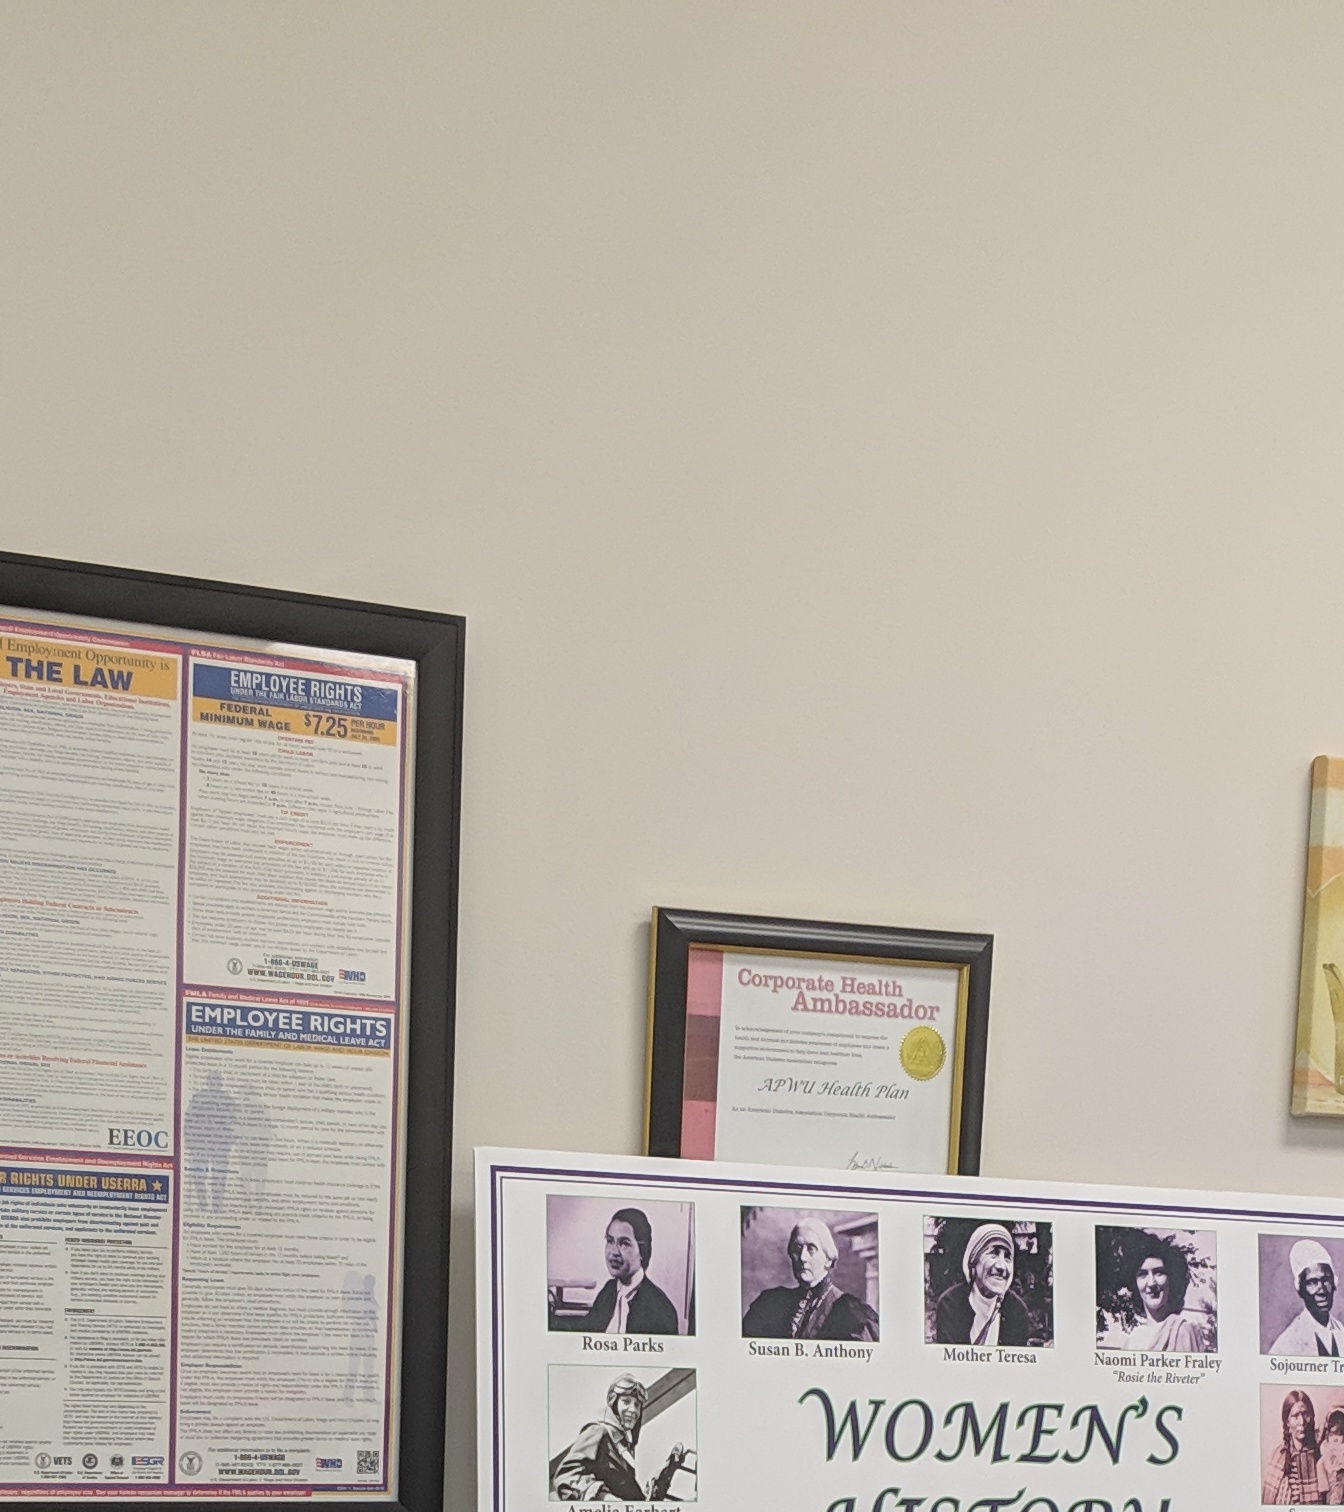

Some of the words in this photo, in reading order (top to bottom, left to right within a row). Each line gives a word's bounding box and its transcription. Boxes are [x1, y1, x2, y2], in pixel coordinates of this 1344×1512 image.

[7, 638, 81, 660] Employment
[86, 650, 156, 671] Opportunity
[160, 659, 170, 671] is
[6, 656, 63, 682] THE
[74, 665, 133, 691] LAW
[231, 671, 306, 694] EMPLOYEE
[311, 681, 362, 702] RIGHTS
[200, 712, 253, 727] MINIMUM
[258, 719, 291, 732] WAGE
[220, 702, 272, 717] FEDERAL
[304, 713, 347, 739] $7.25
[738, 968, 834, 993] Corporate
[840, 975, 903, 998] Health
[792, 991, 940, 1021] Ambassador
[191, 1006, 303, 1030] EMPLOYEE
[310, 1015, 387, 1036] RIGHTS
[191, 1025, 223, 1035] UNDER
[225, 1027, 243, 1036] THE
[245, 1029, 275, 1039] FAMILY
[278, 1032, 298, 1041] AND
[300, 1034, 337, 1043] MEDICAL
[340, 1037, 366, 1045] LEAVE
[368, 1039, 385, 1047] ACT
[758, 1078, 816, 1096] APWU
[817, 1079, 871, 1099] Health
[874, 1083, 910, 1100] Plan
[107, 1128, 169, 1149] EEOC
[11, 1171, 54, 1186] RIGHTS
[58, 1175, 98, 1188] UNDER
[102, 1177, 147, 1191] USERRA
[582, 1336, 618, 1352] Rosa
[623, 1338, 664, 1353] Parks
[748, 1342, 789, 1357] Susan
[794, 1344, 809, 1358] B.
[813, 1344, 874, 1363] Anthony
[943, 1347, 994, 1364] Mother
[997, 1350, 1036, 1364] Teresa
[1094, 1352, 1137, 1368] Naomi
[1140, 1354, 1182, 1370] Parker
[1185, 1354, 1222, 1372] Fraley
[1270, 1357, 1327, 1375] Sojourner
[1145, 1371, 1163, 1383] the
[797, 1387, 1184, 1466] WOMEN'S
[53, 1456, 73, 1466] VETS
